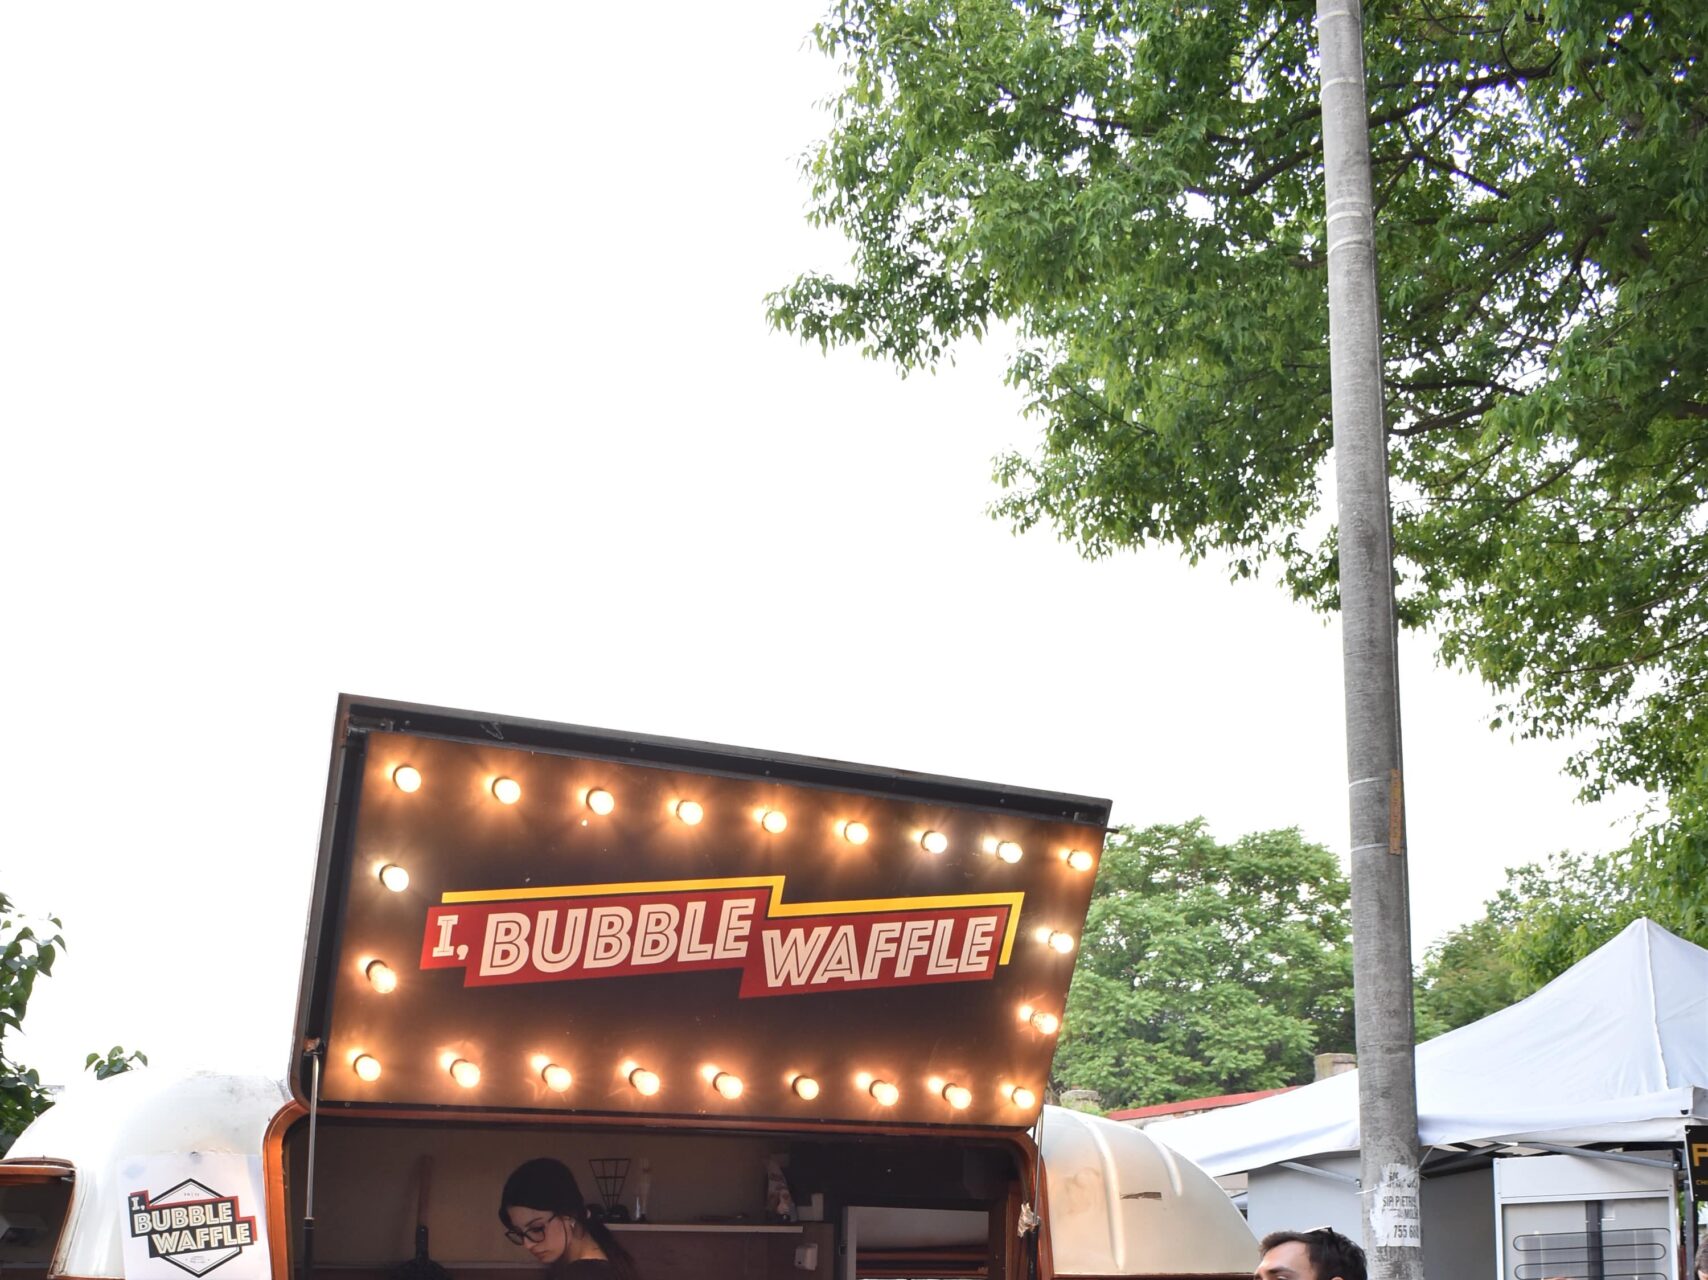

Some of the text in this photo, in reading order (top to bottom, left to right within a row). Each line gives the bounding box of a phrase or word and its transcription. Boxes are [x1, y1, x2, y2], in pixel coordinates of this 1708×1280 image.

[479, 898, 756, 977] BUBBLE
[762, 916, 998, 988] WAFFLE
[133, 1202, 233, 1235] BUBBLE
[151, 1223, 251, 1255] WAFFLE
